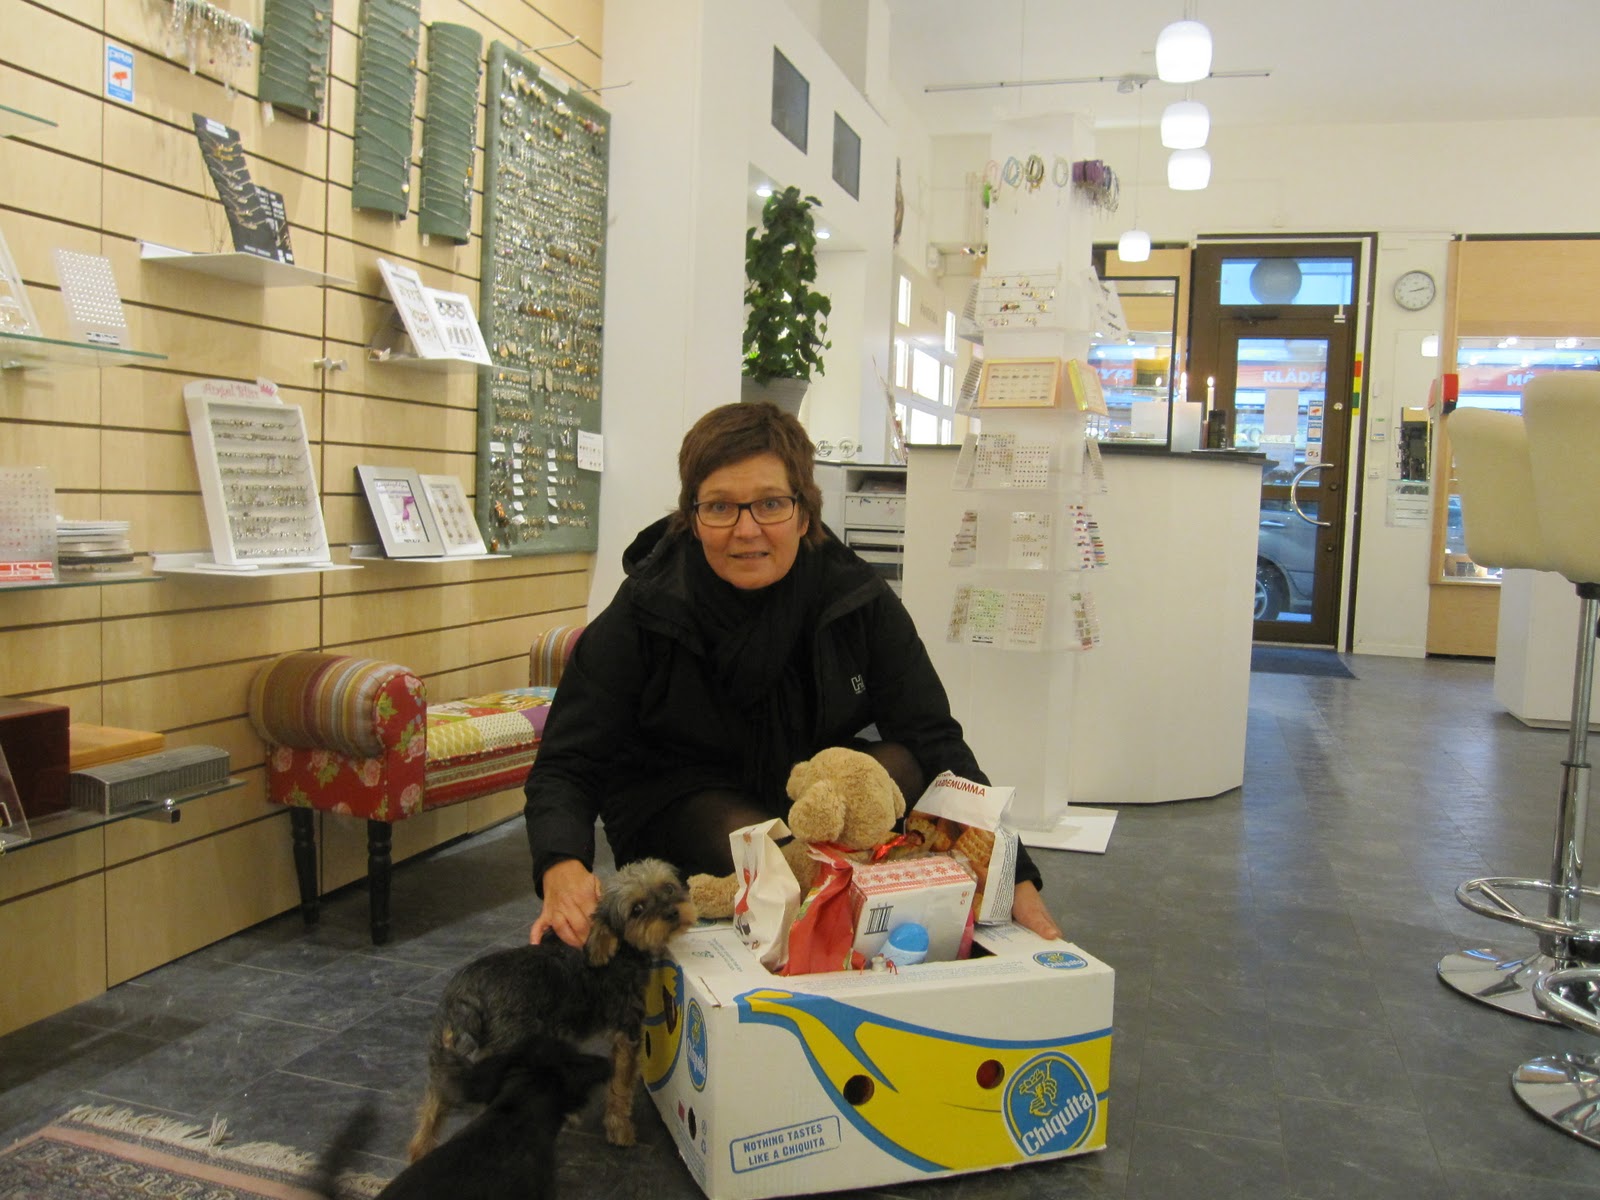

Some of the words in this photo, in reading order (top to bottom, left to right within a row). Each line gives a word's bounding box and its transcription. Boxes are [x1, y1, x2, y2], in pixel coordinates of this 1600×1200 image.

[743, 1134, 785, 1153] NOTHING
[787, 1123, 823, 1142] TASTES
[1021, 1091, 1094, 1155] Chiquita
[748, 1151, 770, 1166] LIKE
[773, 1149, 780, 1160] A
[782, 1137, 826, 1157] CHIQUITA
